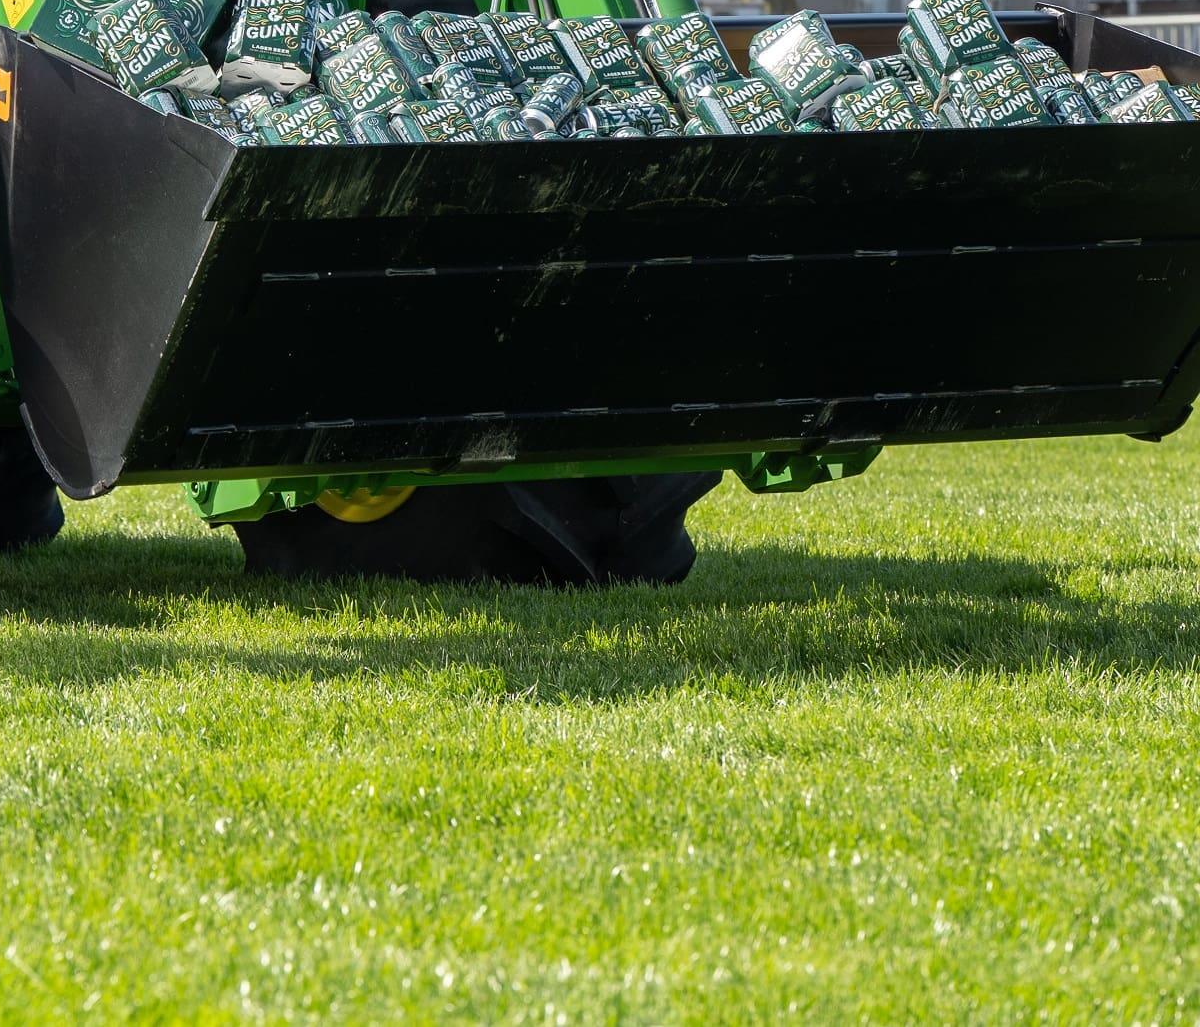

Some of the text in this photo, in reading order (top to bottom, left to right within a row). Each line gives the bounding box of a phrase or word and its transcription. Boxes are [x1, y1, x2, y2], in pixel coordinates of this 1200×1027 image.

[268, 8, 283, 22] &
[956, 12, 971, 25] &
[246, 23, 299, 39] GUNN
[442, 19, 478, 33] INNIS
[500, 15, 539, 34] INNIS
[573, 18, 614, 40] INNIS
[661, 17, 704, 46] INNIS
[949, 17, 992, 48] GUNN
[132, 28, 148, 43] &
[522, 32, 535, 44] &
[597, 37, 611, 50] &
[129, 27, 172, 74] GUNN
[252, 43, 272, 52] LAGER
[516, 42, 556, 62] GUNN
[685, 40, 700, 52] &
[335, 40, 379, 83] INNIS
[457, 46, 495, 63] GUNN
[590, 45, 632, 69] GUNN
[1021, 48, 1057, 64] INNIS
[359, 68, 373, 82] &
[784, 47, 824, 90] GUNN
[974, 63, 1016, 92] INNIS
[353, 68, 397, 109] GUNN
[462, 87, 476, 99] &
[723, 81, 766, 107] INNIS
[996, 85, 1011, 98] &
[188, 99, 223, 110] INNIS
[852, 82, 895, 115] INNIS
[990, 90, 1034, 121] GUNN
[417, 103, 460, 126] INNIS
[747, 102, 762, 114] &
[875, 105, 890, 118] &
[276, 101, 323, 136] INNIS
[740, 108, 785, 135] GUNN
[301, 125, 316, 138] &
[441, 122, 455, 134] &
